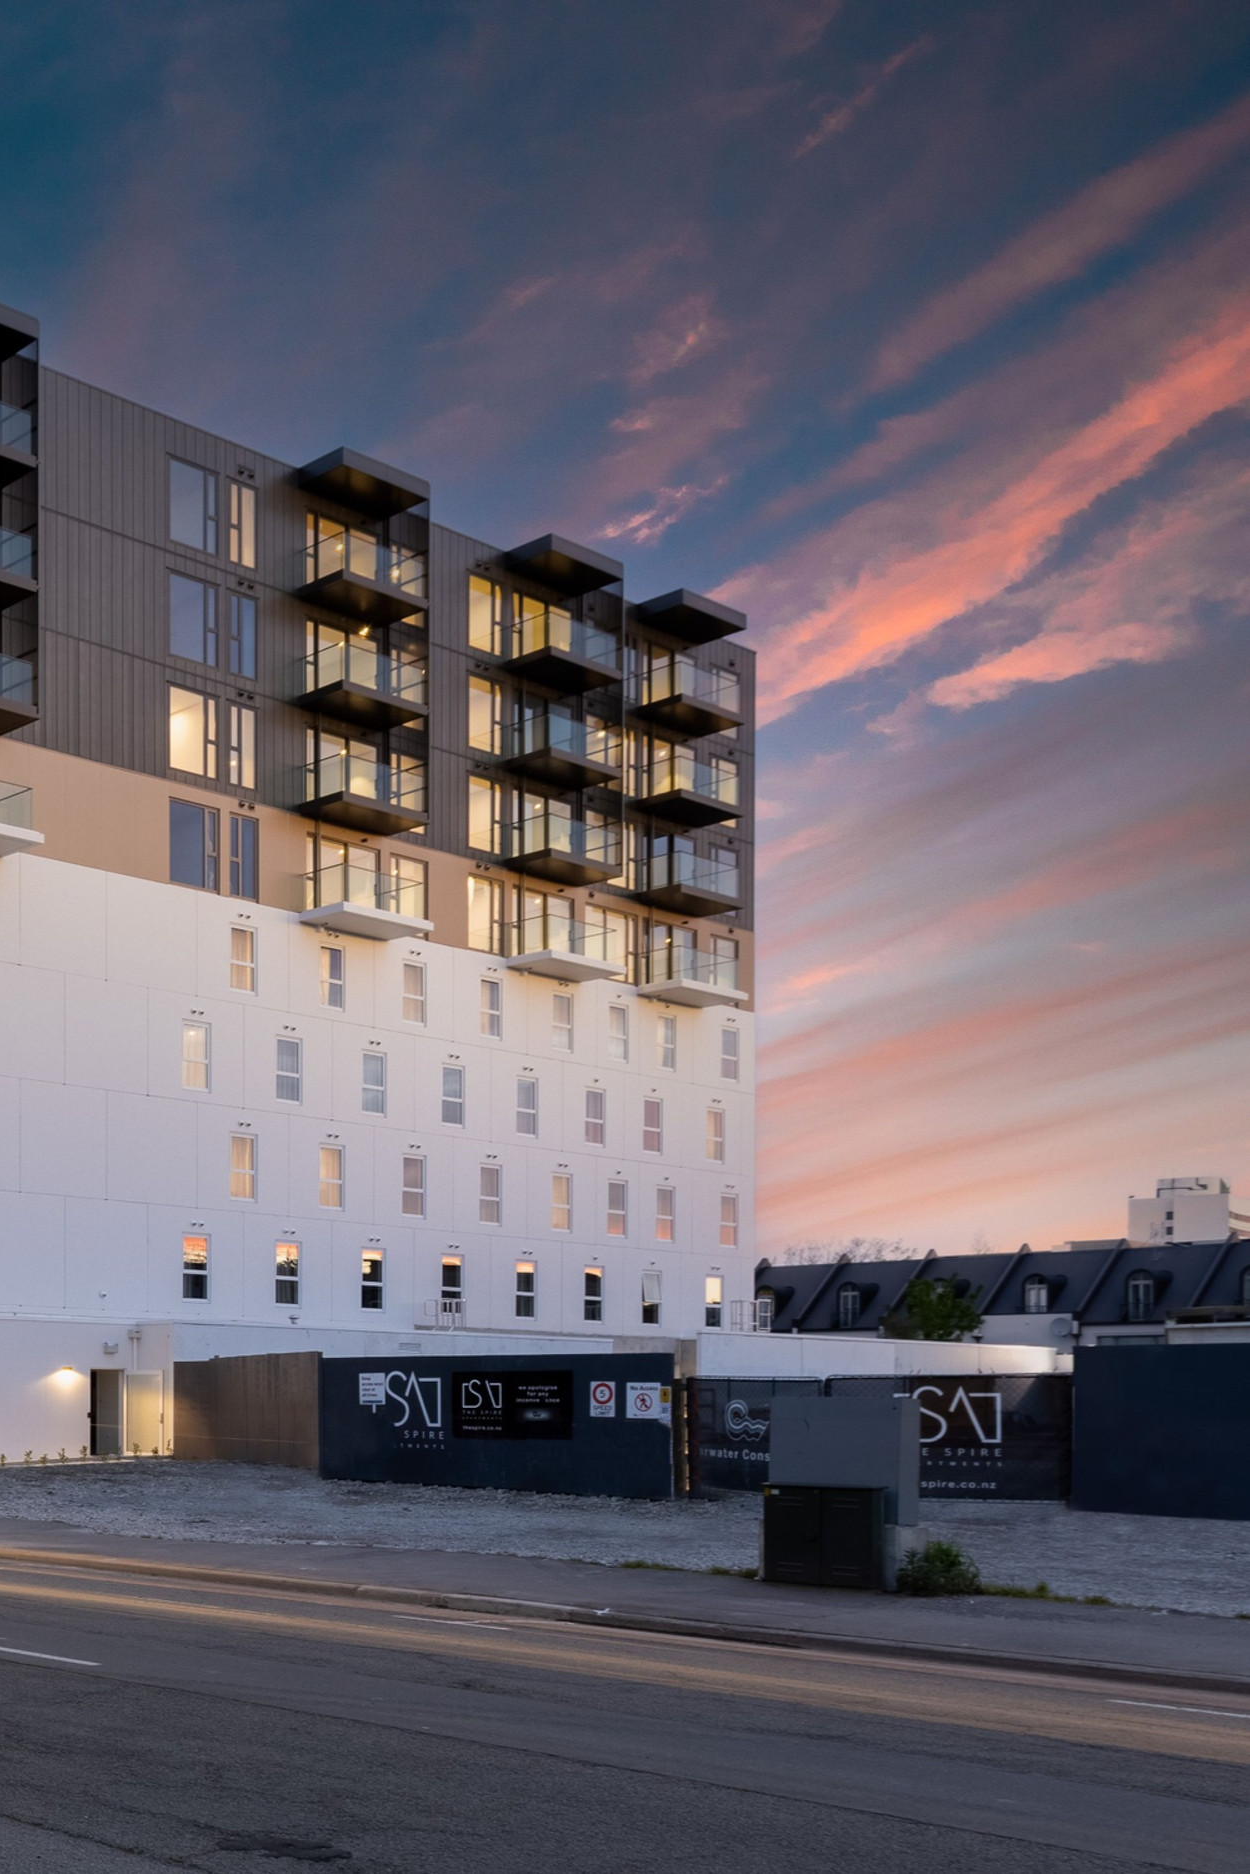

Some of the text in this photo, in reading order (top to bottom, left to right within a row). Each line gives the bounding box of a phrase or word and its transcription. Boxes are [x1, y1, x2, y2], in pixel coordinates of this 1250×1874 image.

[599, 1389, 606, 1398] 5
[403, 1430, 445, 1440] SPIRE
[395, 1442, 445, 1450] TMENTS
[944, 1448, 1002, 1457] SPIRE
